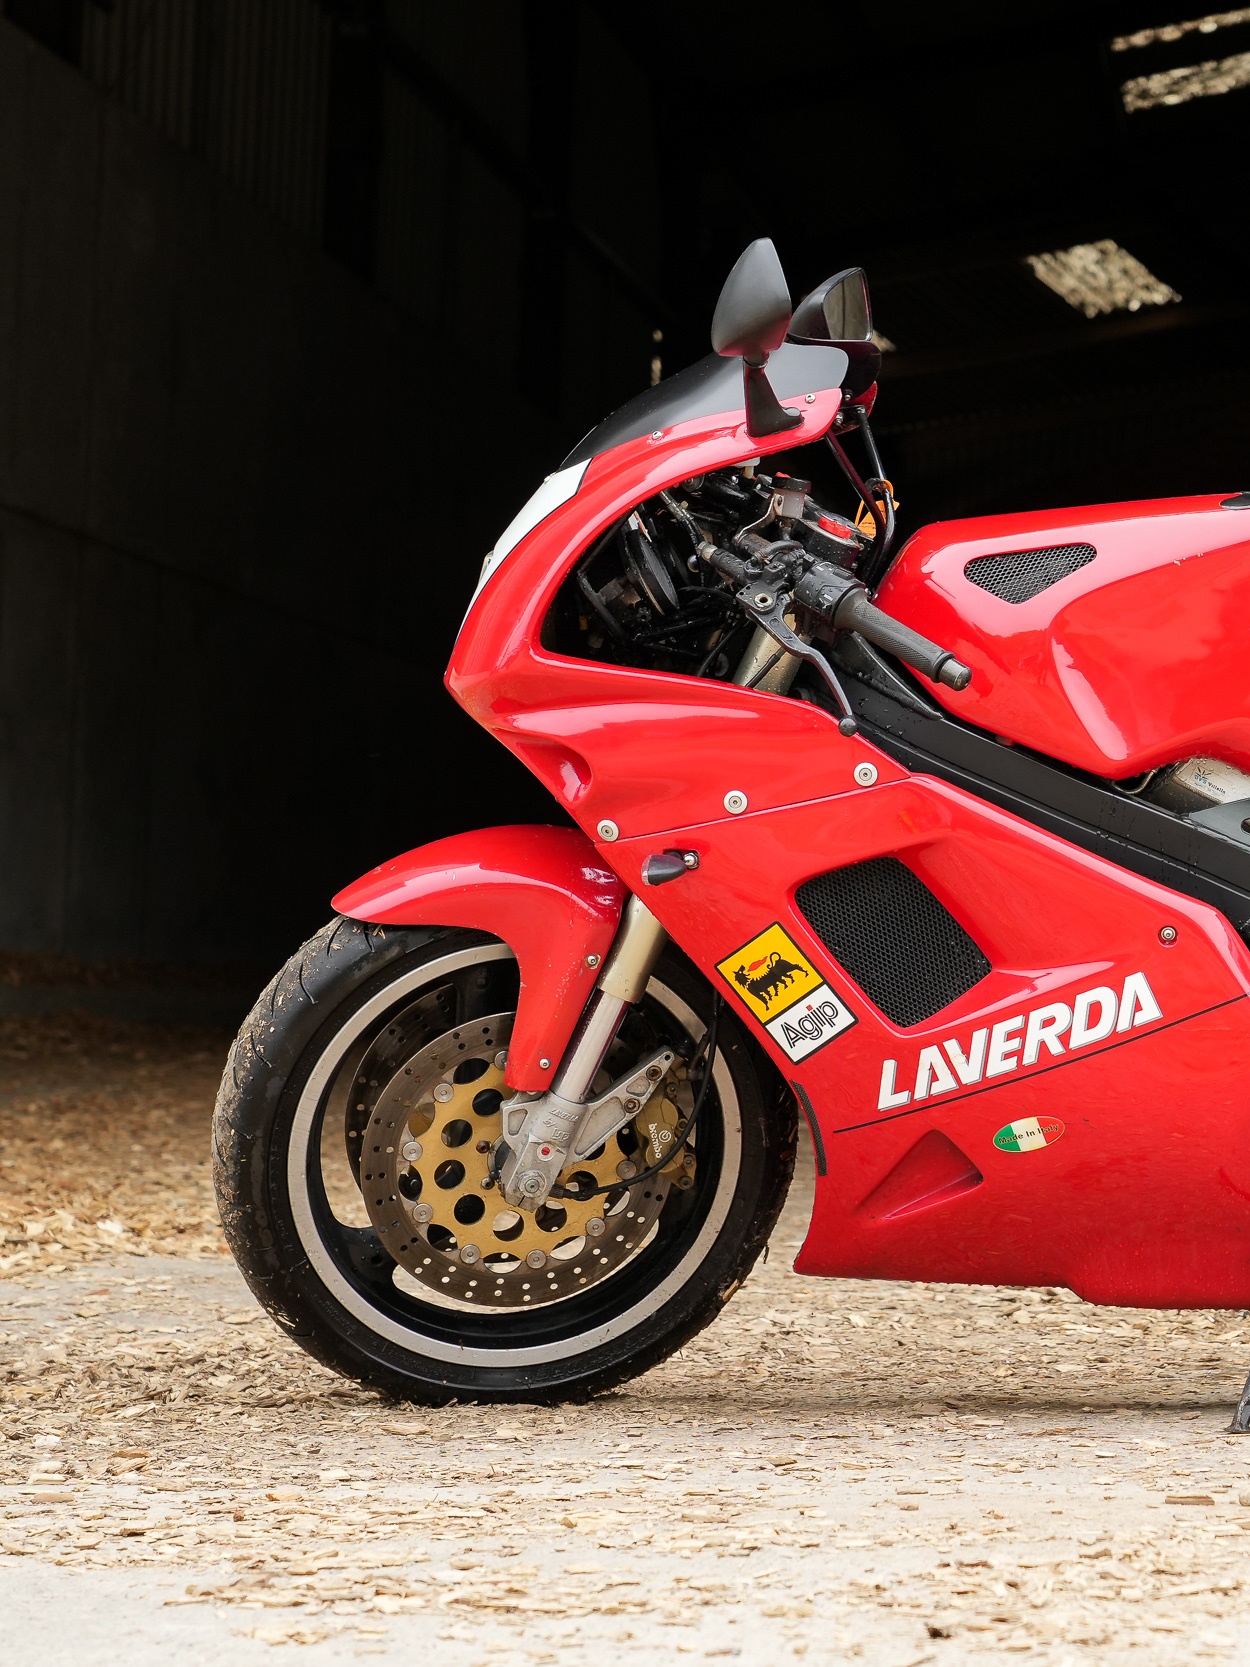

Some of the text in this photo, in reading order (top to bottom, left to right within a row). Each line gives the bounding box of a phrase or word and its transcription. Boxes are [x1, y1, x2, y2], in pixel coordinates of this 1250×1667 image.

[781, 1001, 839, 1049] Agip
[877, 971, 1164, 1111] LAVERDA
[648, 1123, 662, 1159] brembo
[999, 1133, 1023, 1144] Made
[1037, 1124, 1059, 1135] Italy
